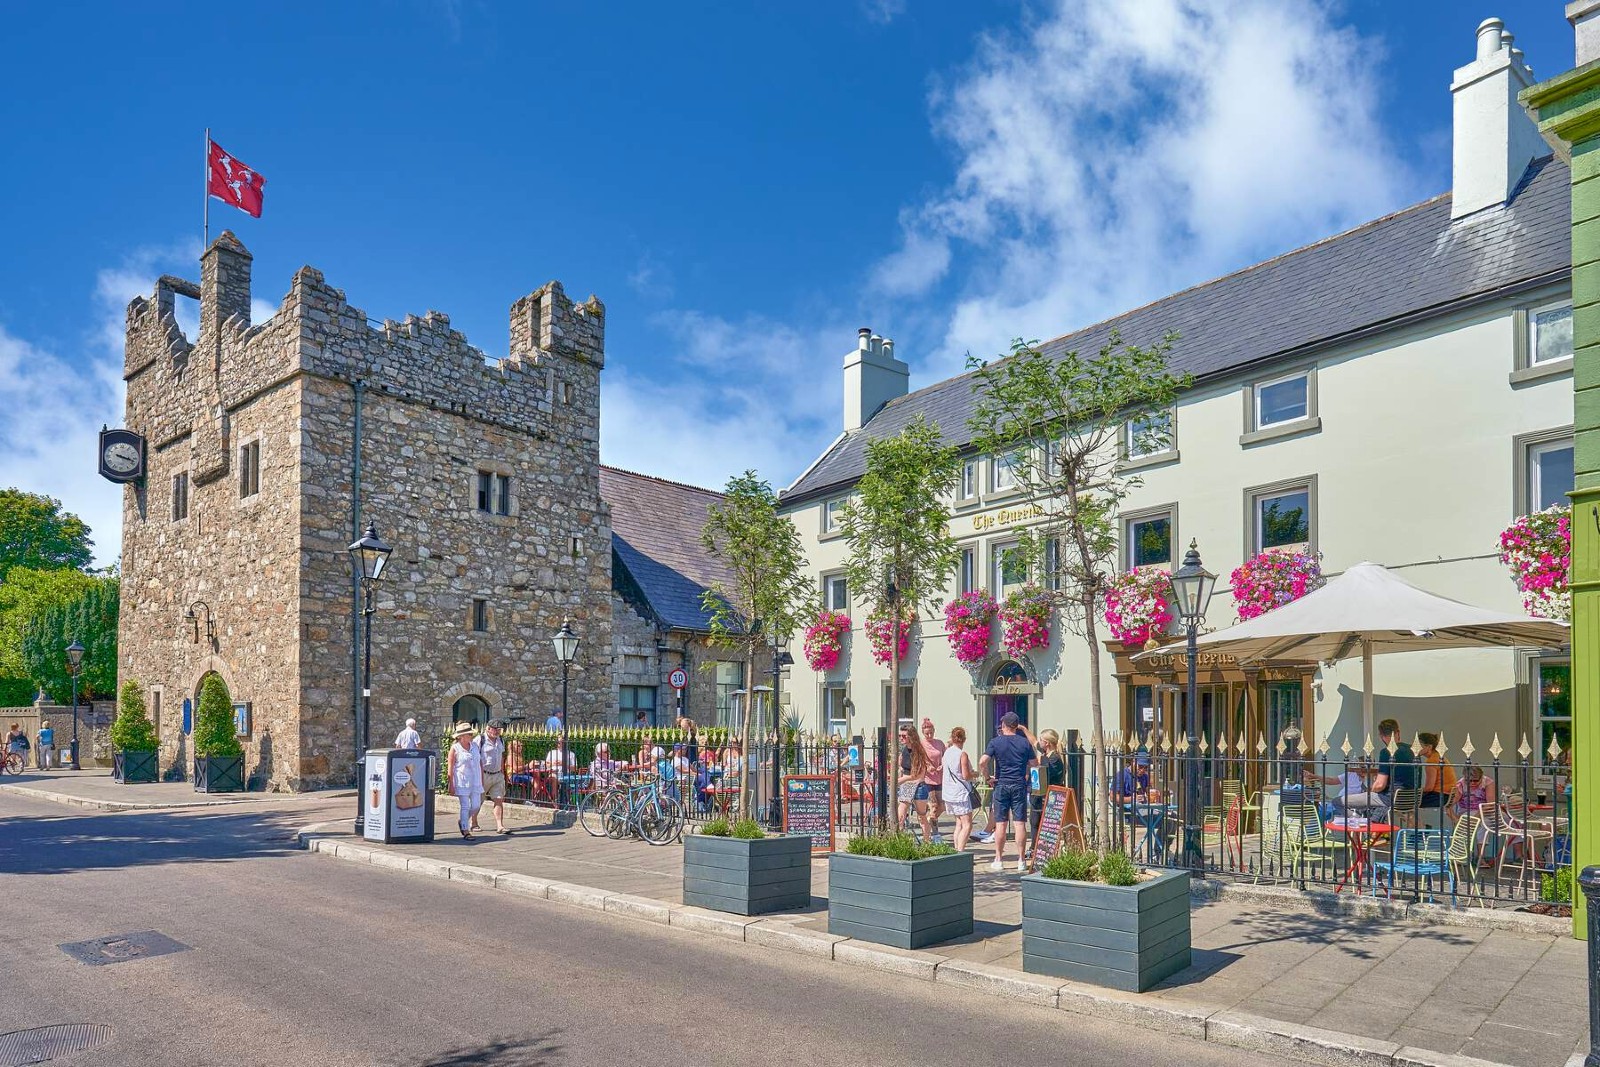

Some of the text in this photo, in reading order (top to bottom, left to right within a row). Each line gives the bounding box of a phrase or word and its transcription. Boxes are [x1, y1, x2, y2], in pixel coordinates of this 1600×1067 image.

[972, 513, 995, 531] The
[1149, 652, 1176, 667] The
[673, 674, 683, 683] 30
